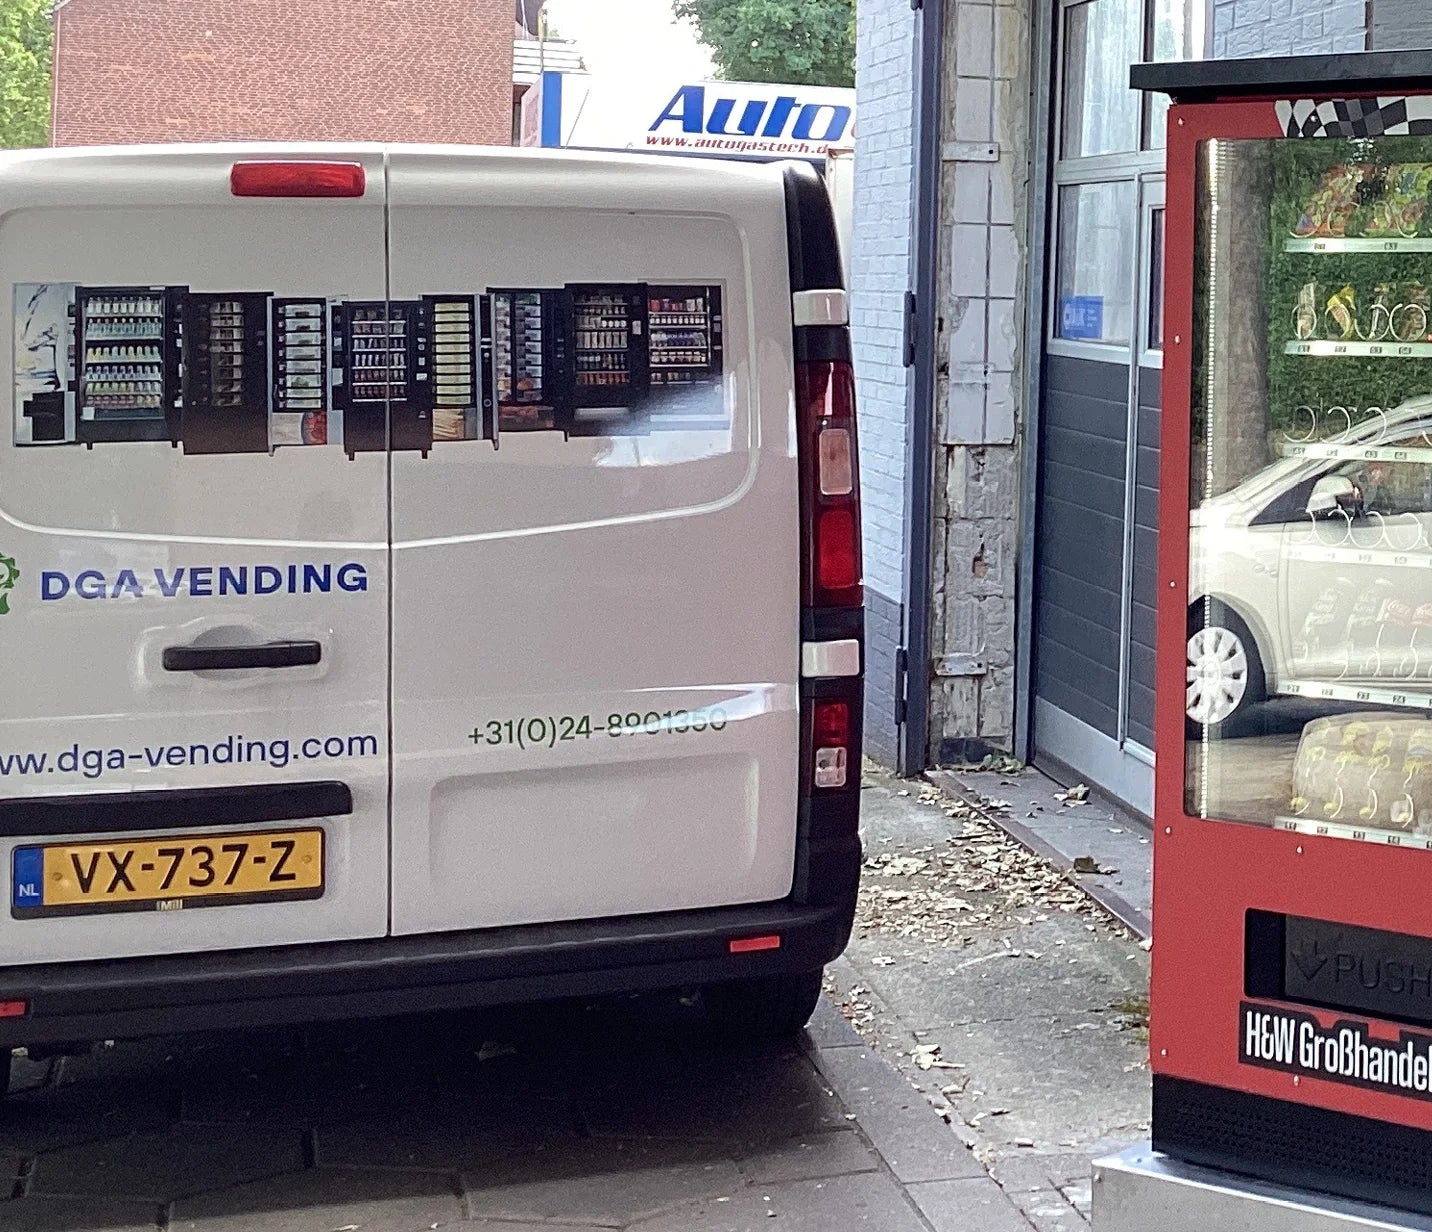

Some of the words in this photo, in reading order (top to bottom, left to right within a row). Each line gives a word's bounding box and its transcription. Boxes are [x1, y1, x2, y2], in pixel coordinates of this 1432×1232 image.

[648, 85, 856, 141] Auto
[646, 136, 828, 153] www.autogastech.d
[41, 569, 143, 601] DGA
[154, 562, 368, 597] VENDING
[71, 840, 297, 894] VX-737-Z
[19, 883, 40, 897] NL
[1335, 954, 1431, 994] PUSH
[1246, 1010, 1295, 1063] H&W
